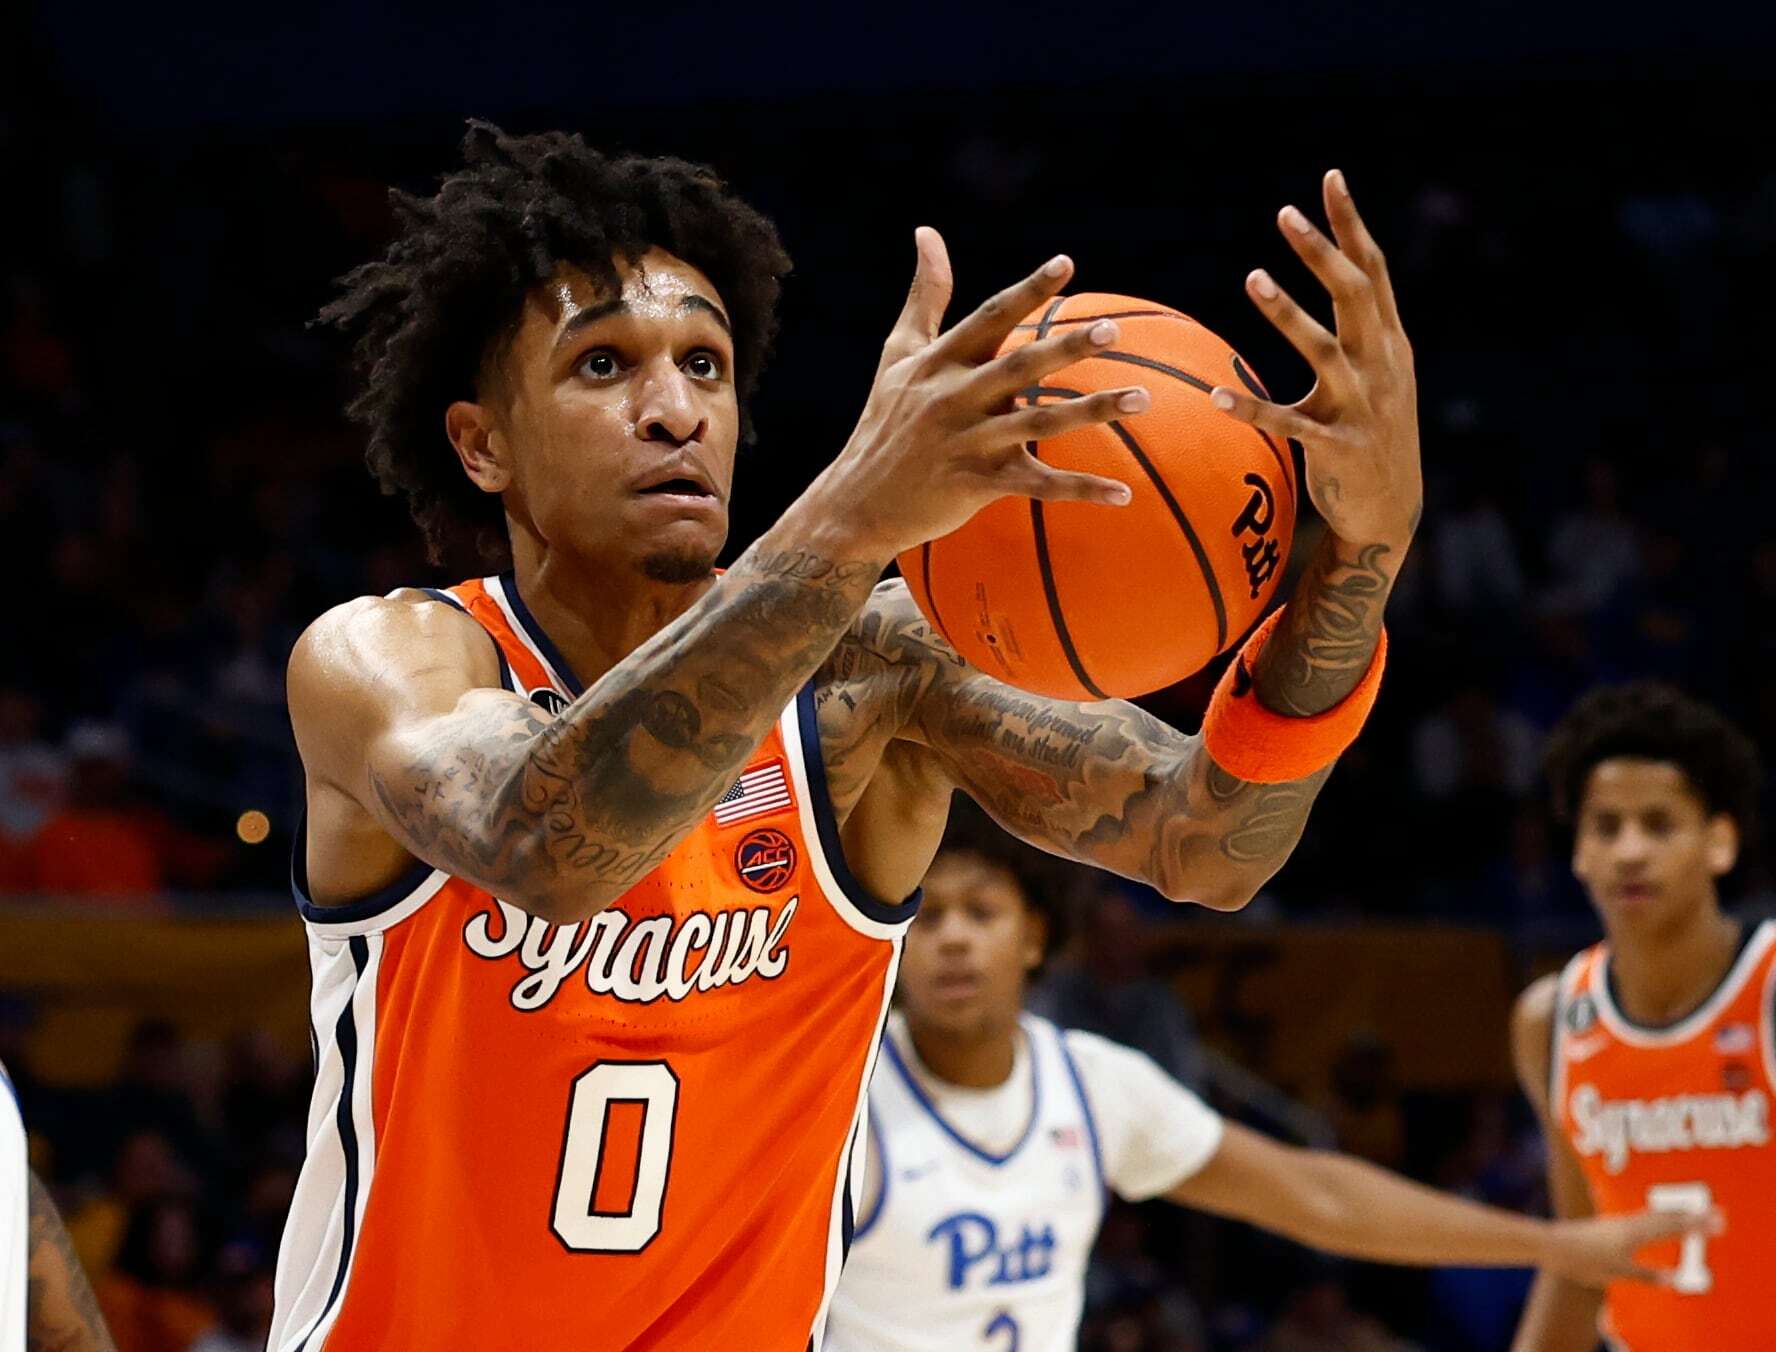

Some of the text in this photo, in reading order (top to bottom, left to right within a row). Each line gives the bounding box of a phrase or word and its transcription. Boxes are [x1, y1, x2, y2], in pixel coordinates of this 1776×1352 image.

[1231, 472, 1280, 599] Pitt
[746, 846, 790, 867] ACC
[463, 896, 800, 1013] Syracuse
[549, 1059, 680, 1255] 0
[1573, 1086, 1767, 1173] Syracuse
[929, 1211, 1053, 1288] Pitt
